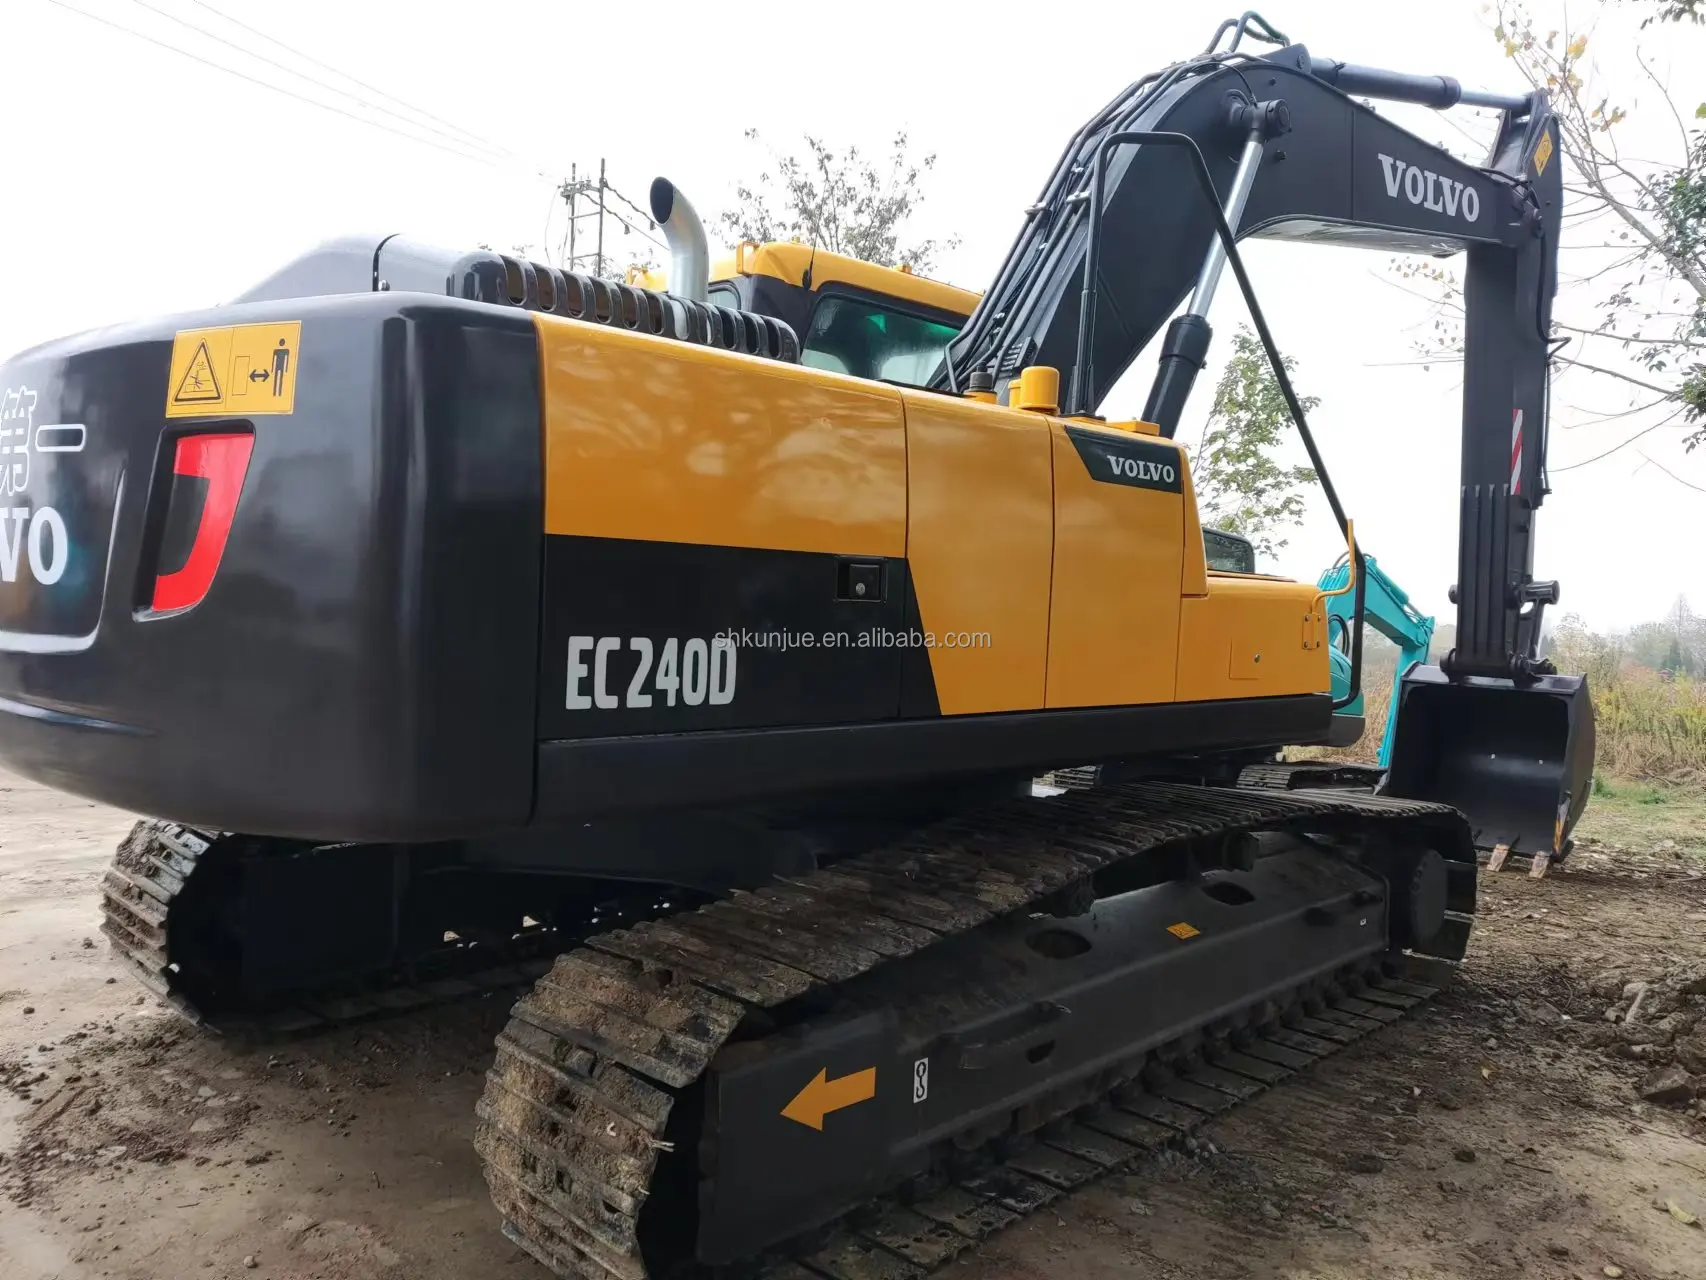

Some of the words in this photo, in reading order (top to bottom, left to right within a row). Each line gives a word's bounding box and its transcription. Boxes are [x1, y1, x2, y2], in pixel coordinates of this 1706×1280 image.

[1377, 152, 1480, 223] VOLVO
[1106, 454, 1175, 483] VOLVO
[565, 635, 737, 710] EC240D
